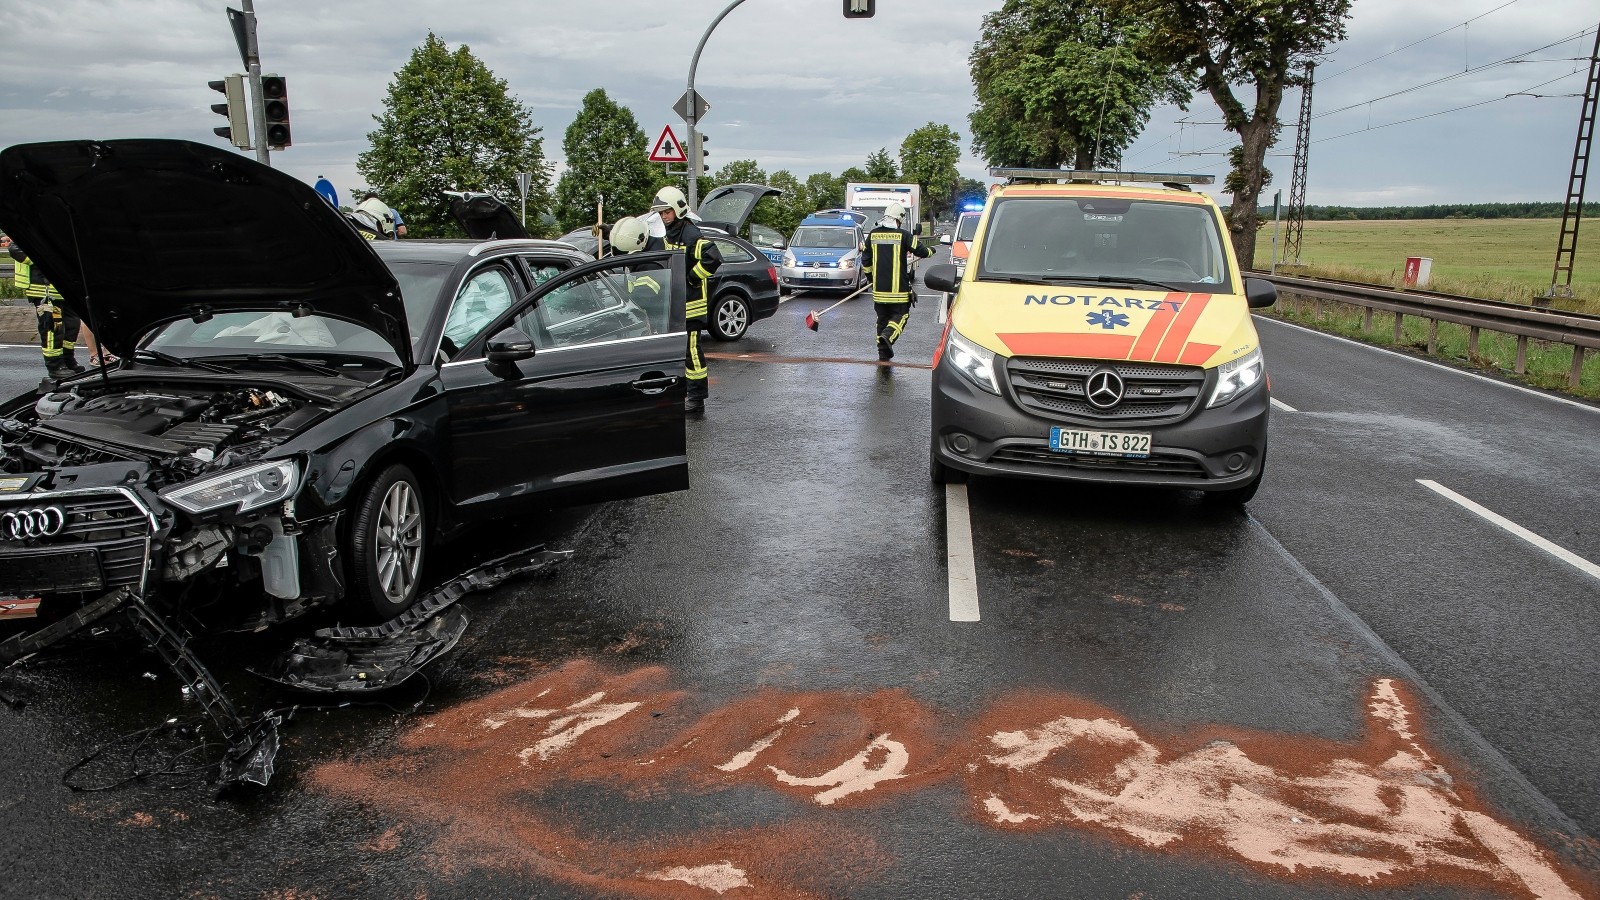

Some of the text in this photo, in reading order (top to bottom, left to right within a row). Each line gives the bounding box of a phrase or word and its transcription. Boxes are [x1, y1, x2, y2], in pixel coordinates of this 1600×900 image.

[1023, 294, 1181, 313] NOTARZT
[1060, 431, 1089, 449] GTH
[1100, 434, 1118, 450] TS
[1122, 436, 1149, 452] 822
